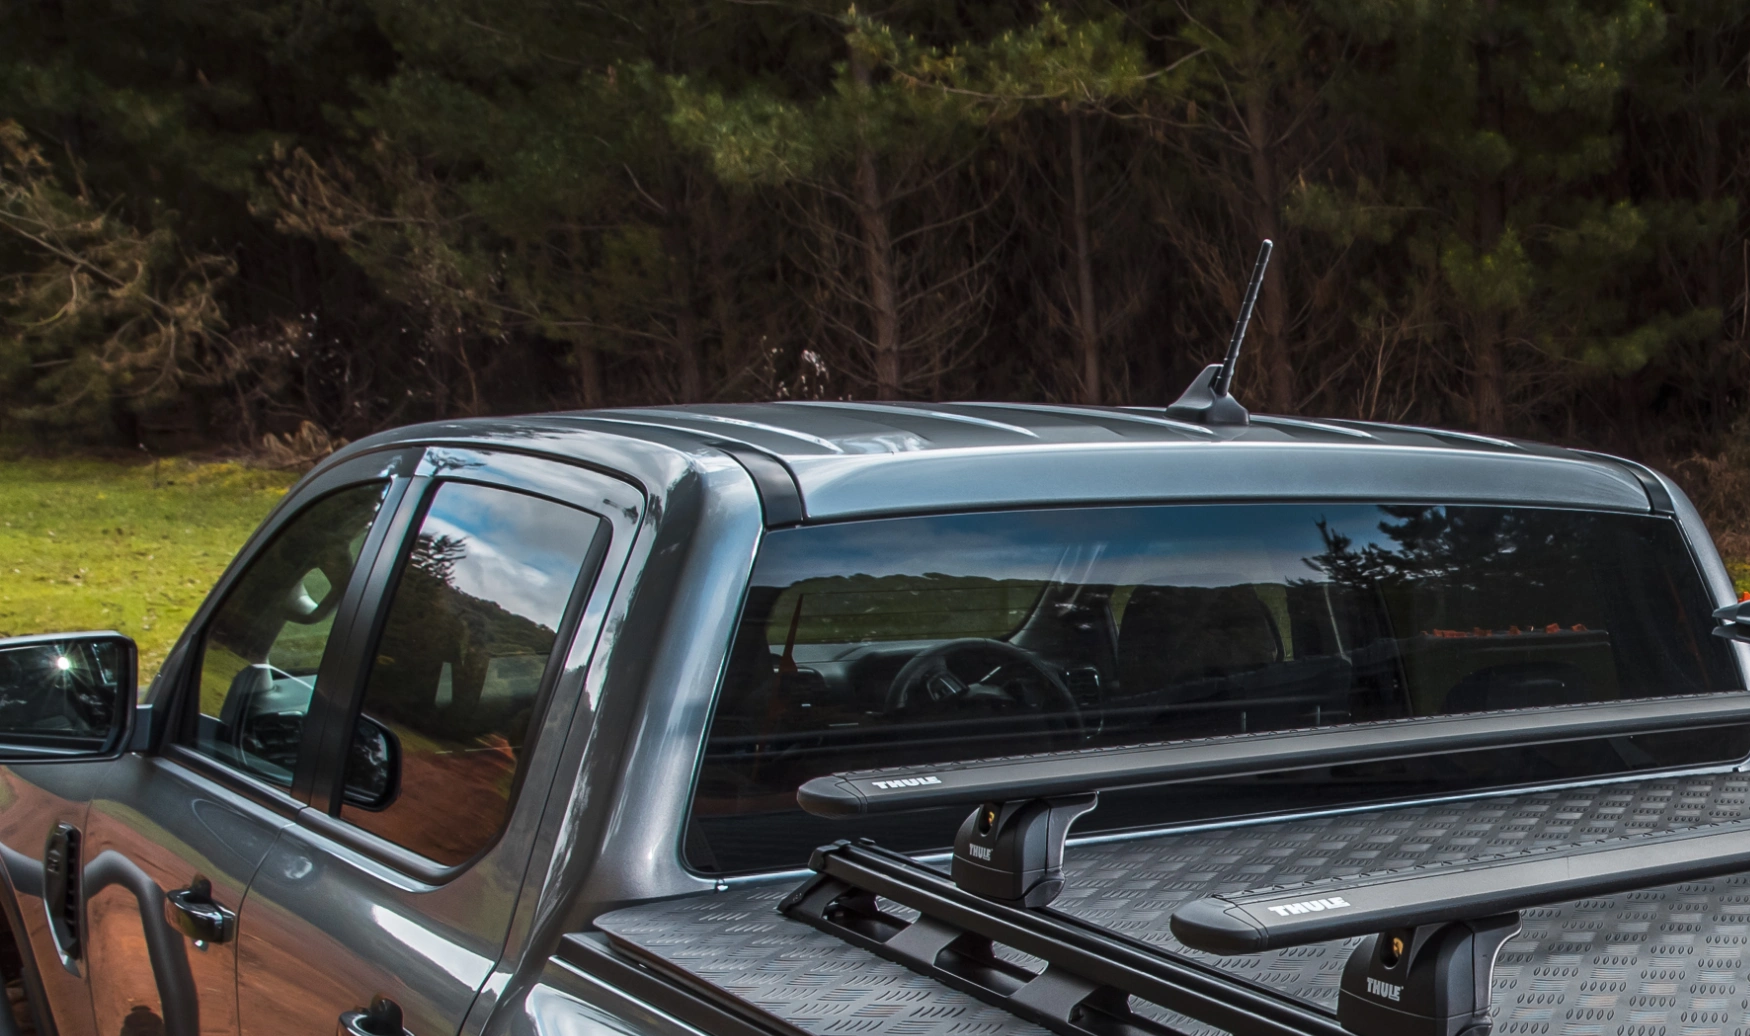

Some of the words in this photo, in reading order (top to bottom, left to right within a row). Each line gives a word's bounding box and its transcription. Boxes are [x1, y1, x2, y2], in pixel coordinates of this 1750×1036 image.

[872, 776, 941, 789] THULE
[969, 843, 993, 861] THULE
[1267, 896, 1351, 916] THULE
[1367, 976, 1401, 1002] THULE
